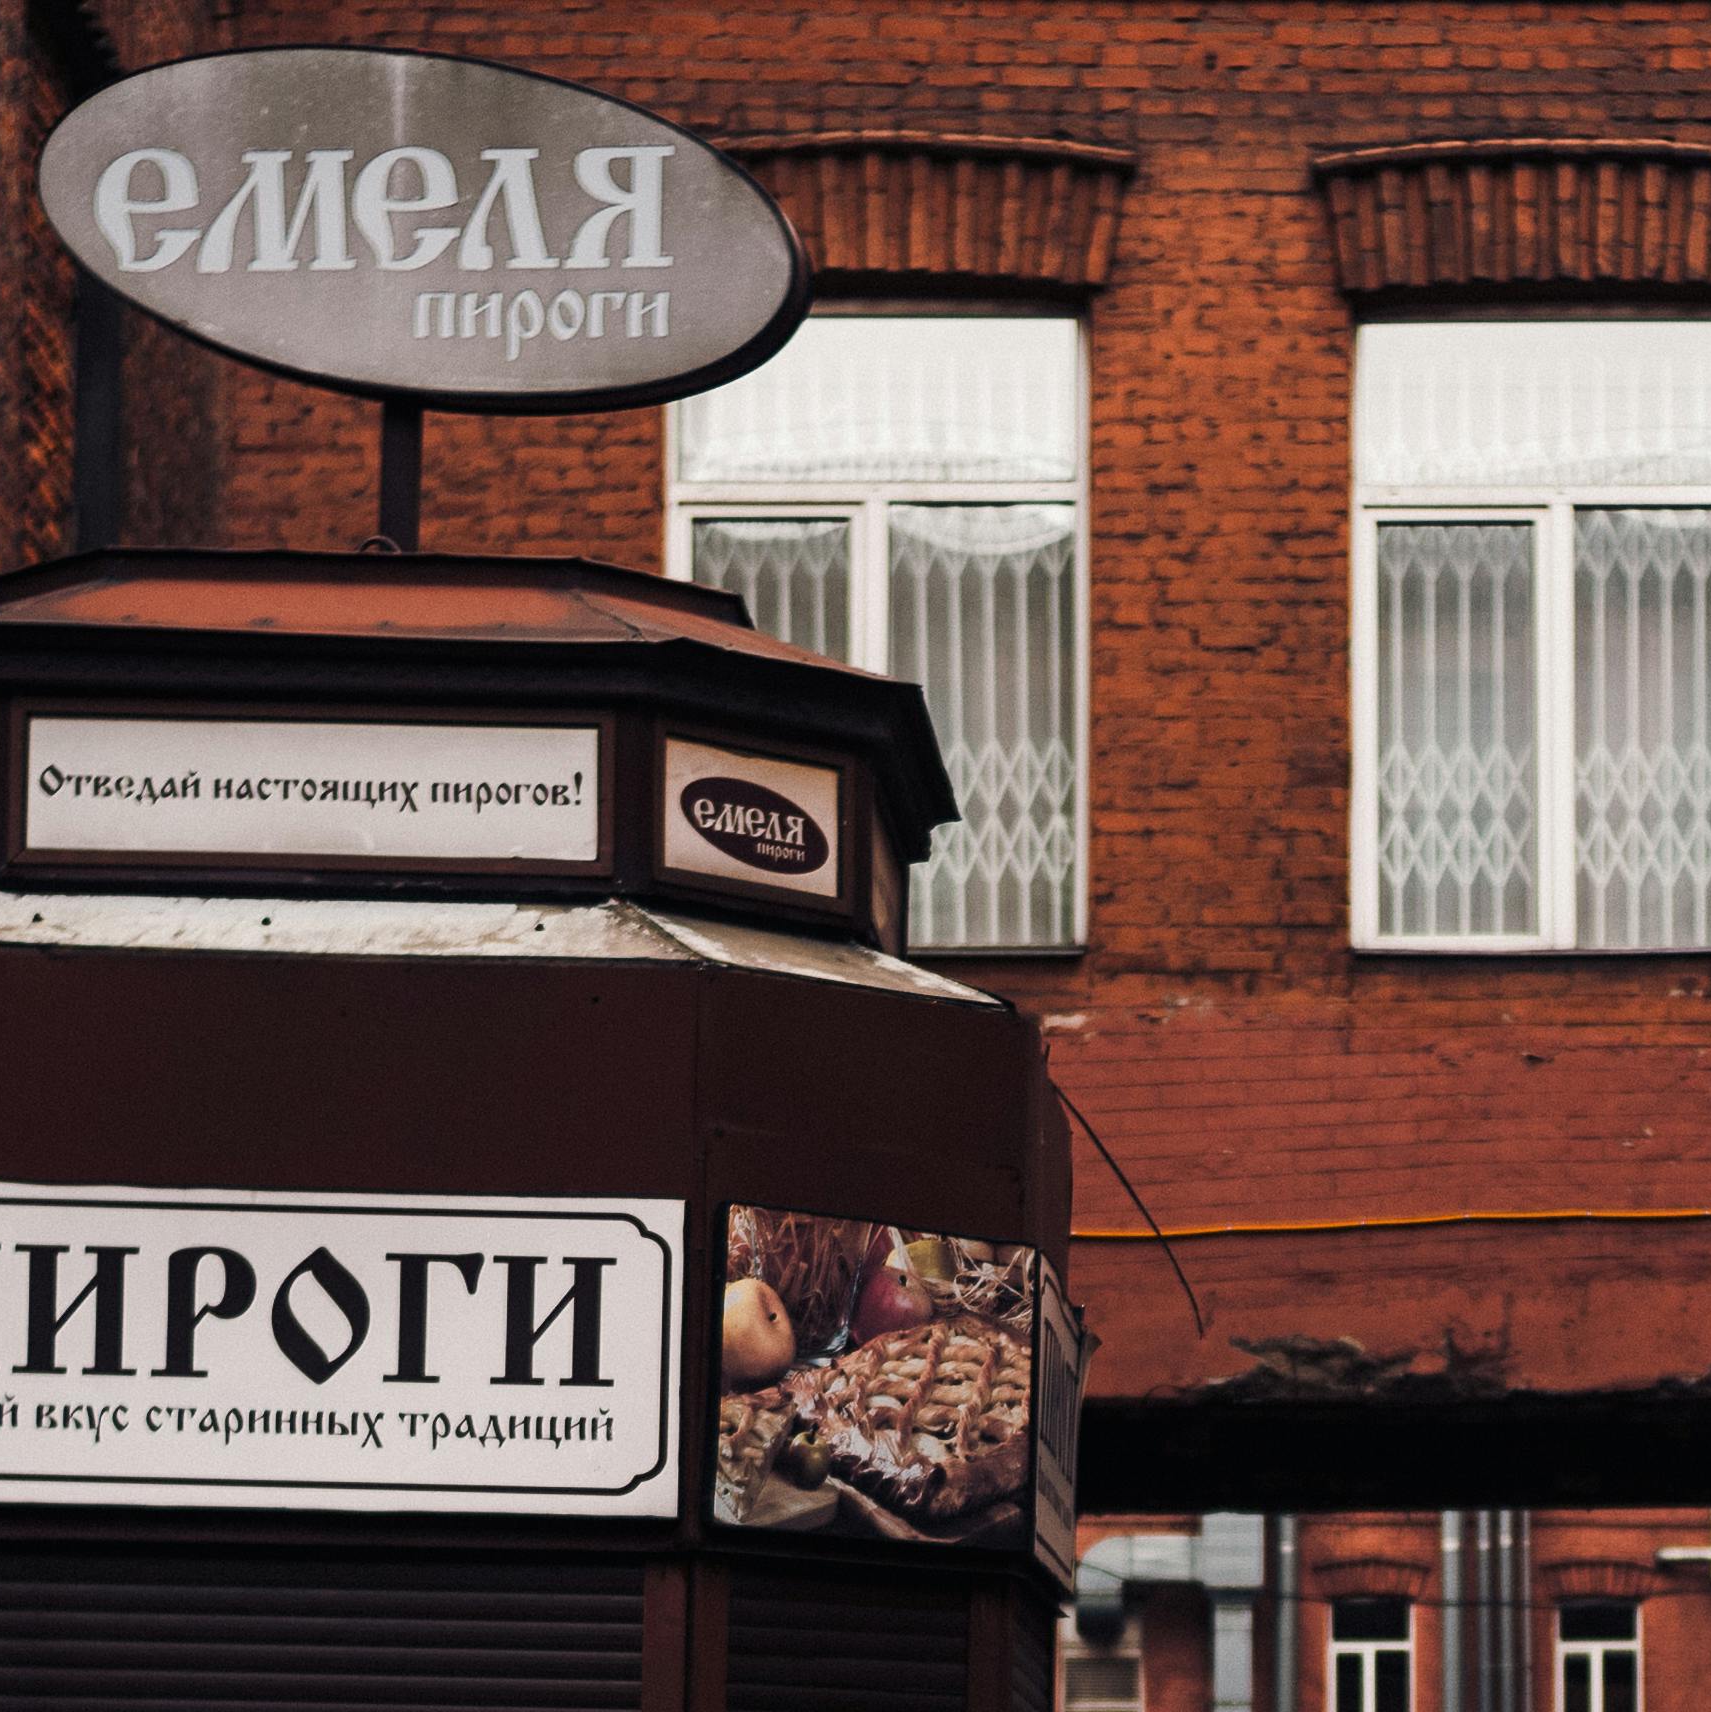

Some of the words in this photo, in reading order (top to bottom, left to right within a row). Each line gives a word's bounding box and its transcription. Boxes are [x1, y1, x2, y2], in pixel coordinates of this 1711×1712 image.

[411, 287, 671, 363] пироги
[38, 764, 200, 805] Отведай
[213, 775, 419, 813] настоящих
[430, 771, 584, 814] пирогов!
[756, 842, 806, 862] пироги
[34, 1402, 129, 1443] вкус
[145, 1401, 386, 1449] старинных
[398, 1407, 615, 1452] традиций
